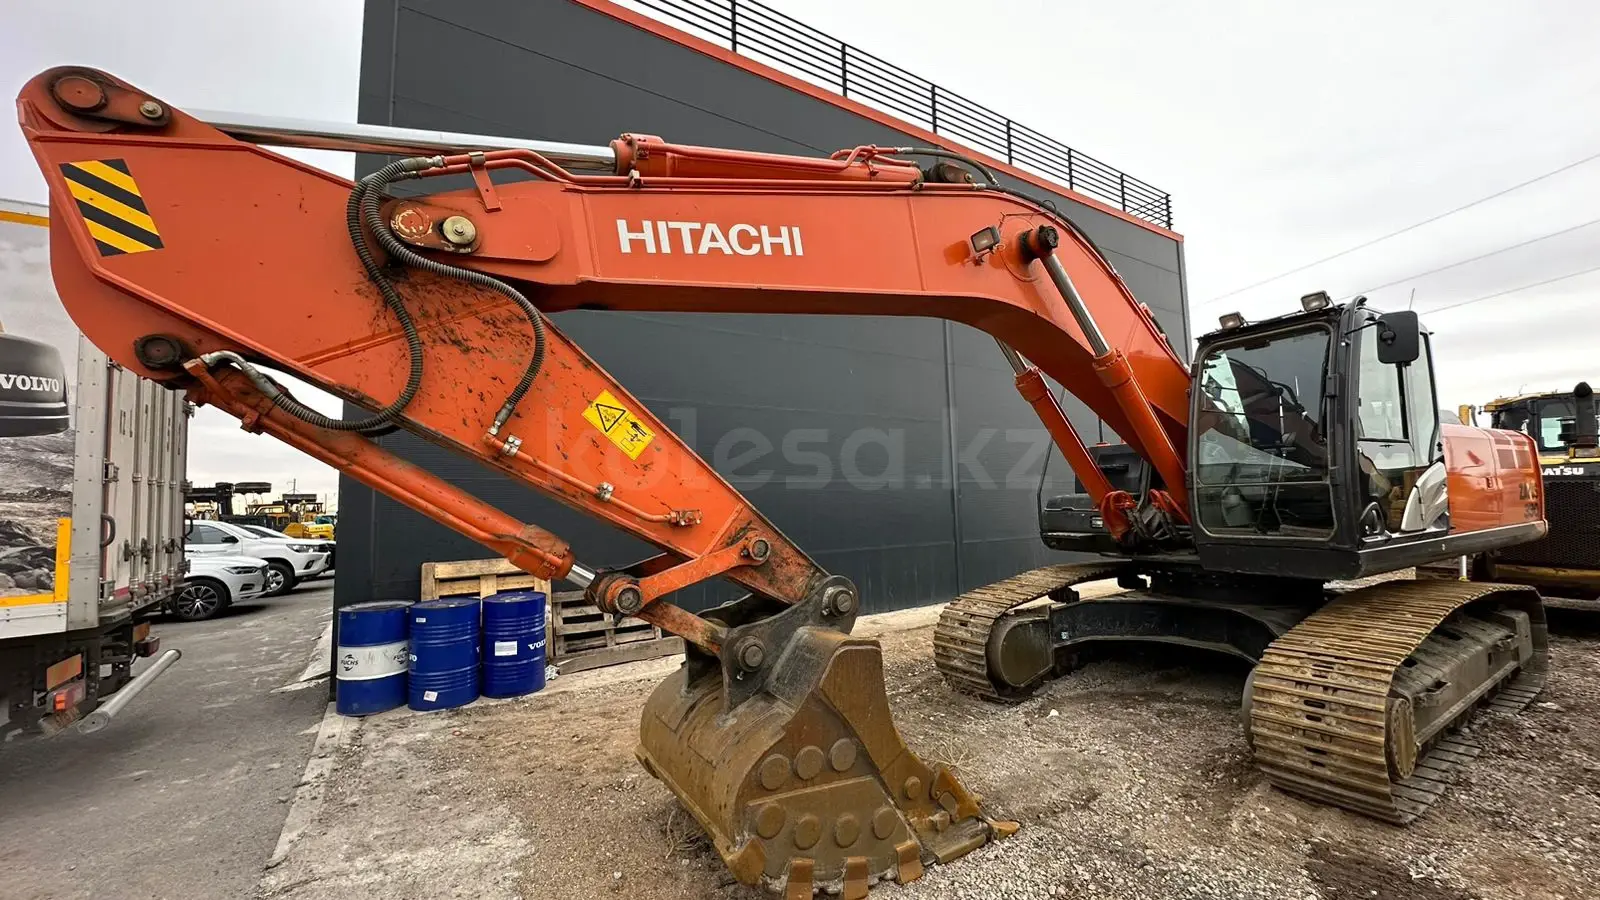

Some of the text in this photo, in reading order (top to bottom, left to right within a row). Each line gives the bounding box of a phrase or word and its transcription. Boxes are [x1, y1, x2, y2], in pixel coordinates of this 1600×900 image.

[616, 219, 804, 256] HITACHI
[0, 373, 60, 393] VOLVO
[1541, 465, 1584, 476] ATSU
